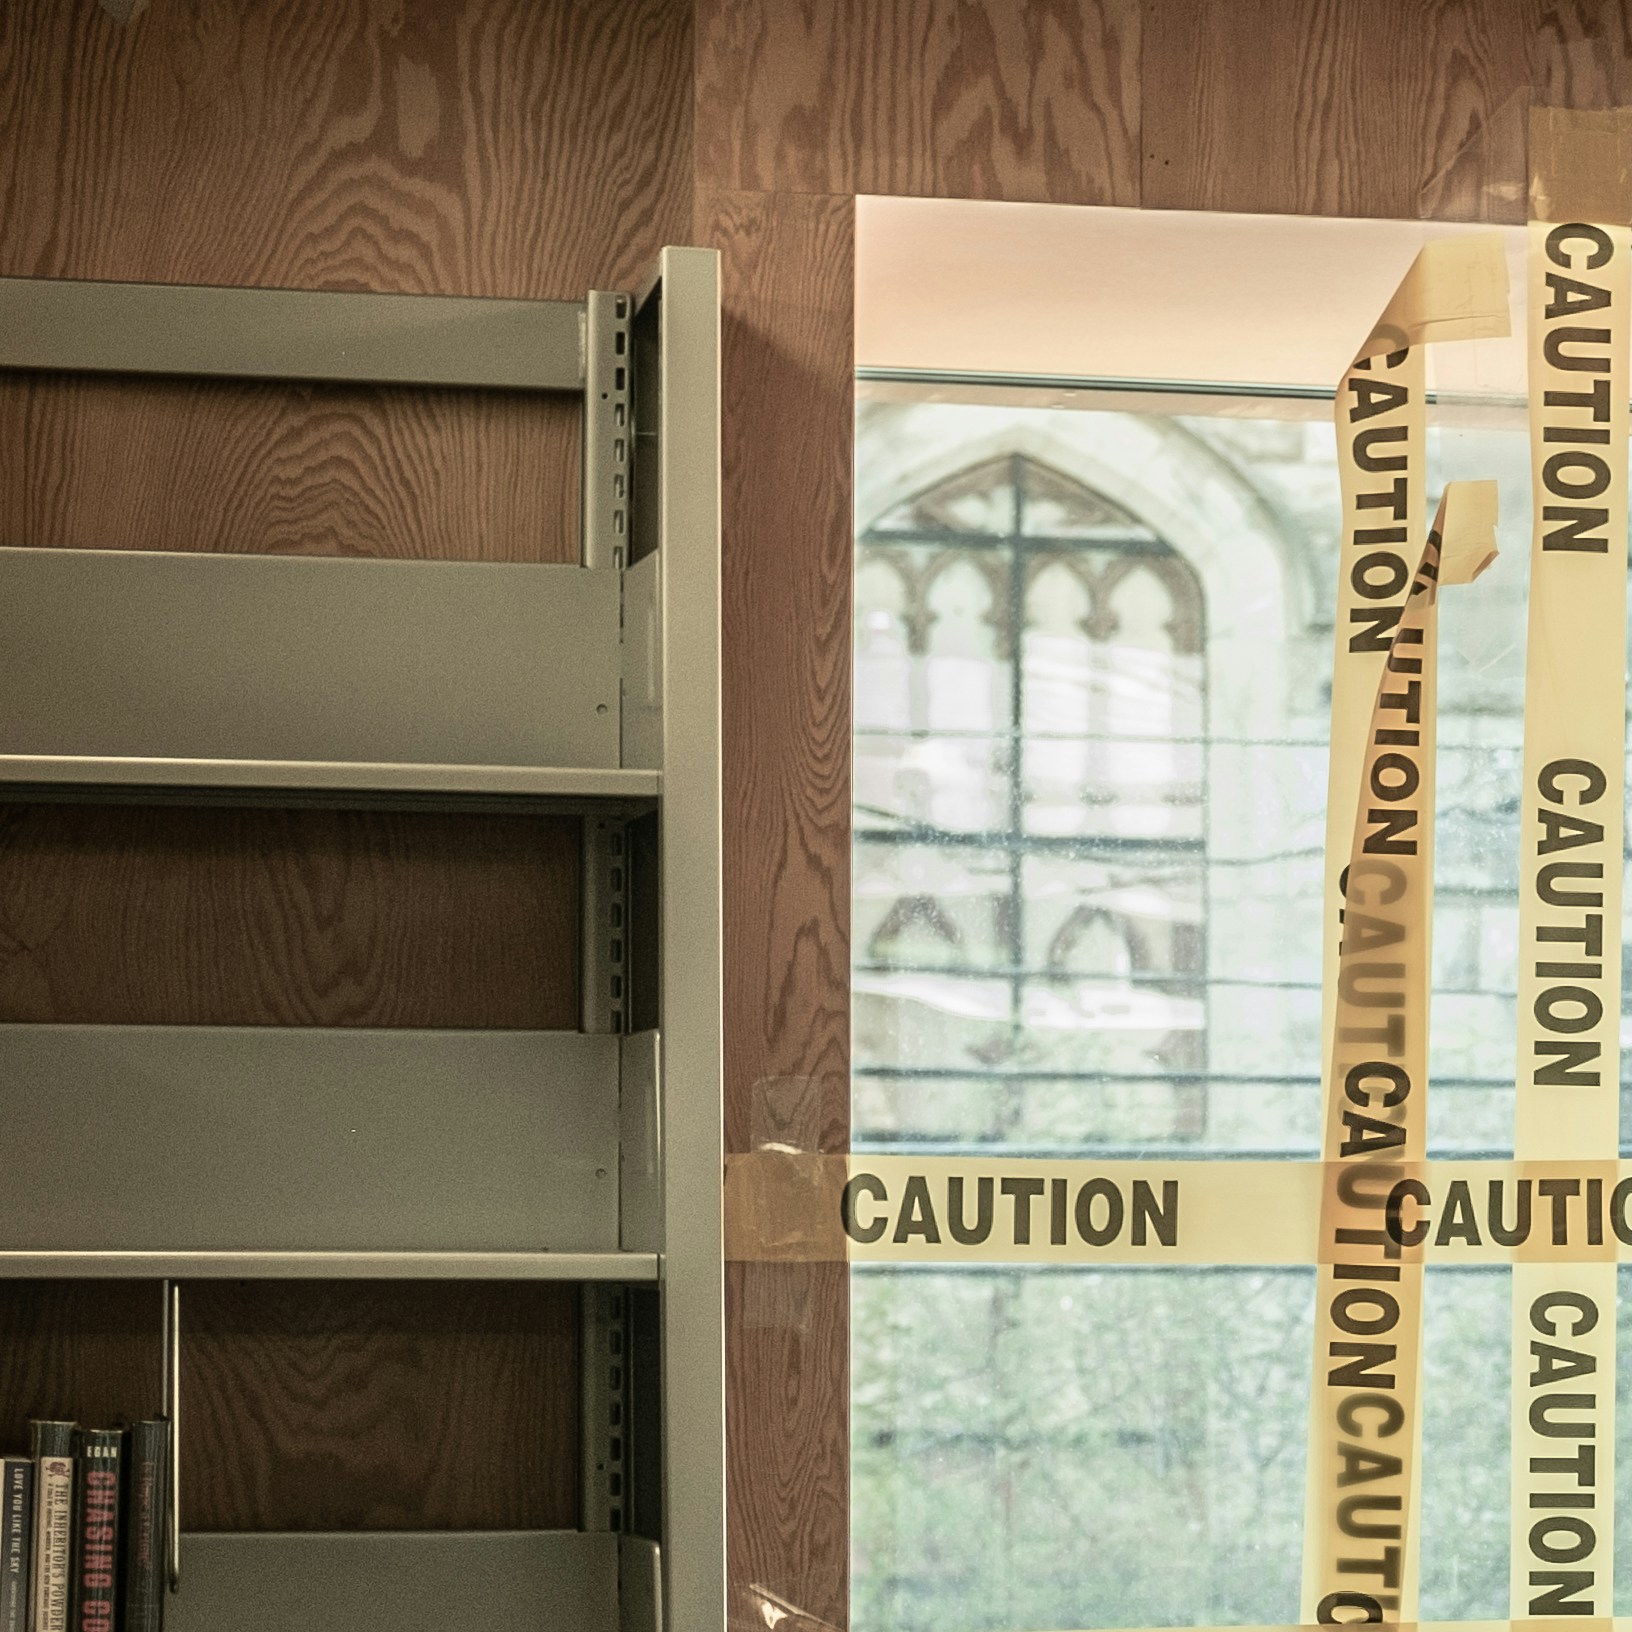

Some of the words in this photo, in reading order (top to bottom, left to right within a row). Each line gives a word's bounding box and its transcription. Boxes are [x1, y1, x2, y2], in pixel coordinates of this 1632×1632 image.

[1542, 223, 1614, 553] CAUTION
[1349, 324, 1409, 653] CAUTION
[1533, 759, 1607, 1086] CAUTION
[841, 1172, 1179, 1247] CAUTION
[1328, 1061, 1410, 1389] CAUTION
[15, 1469, 24, 1489] LOVE
[1528, 1291, 1599, 1616] CAUTION
[14, 1511, 22, 1533] LIKE
[15, 1494, 23, 1509] YOU
[58, 1484, 68, 1505] THE
[11, 1556, 20, 1574] SKY
[13, 1536, 21, 1554] THE
[54, 1508, 68, 1579] INHERITOR'S
[51, 1583, 64, 1632] POWDER
